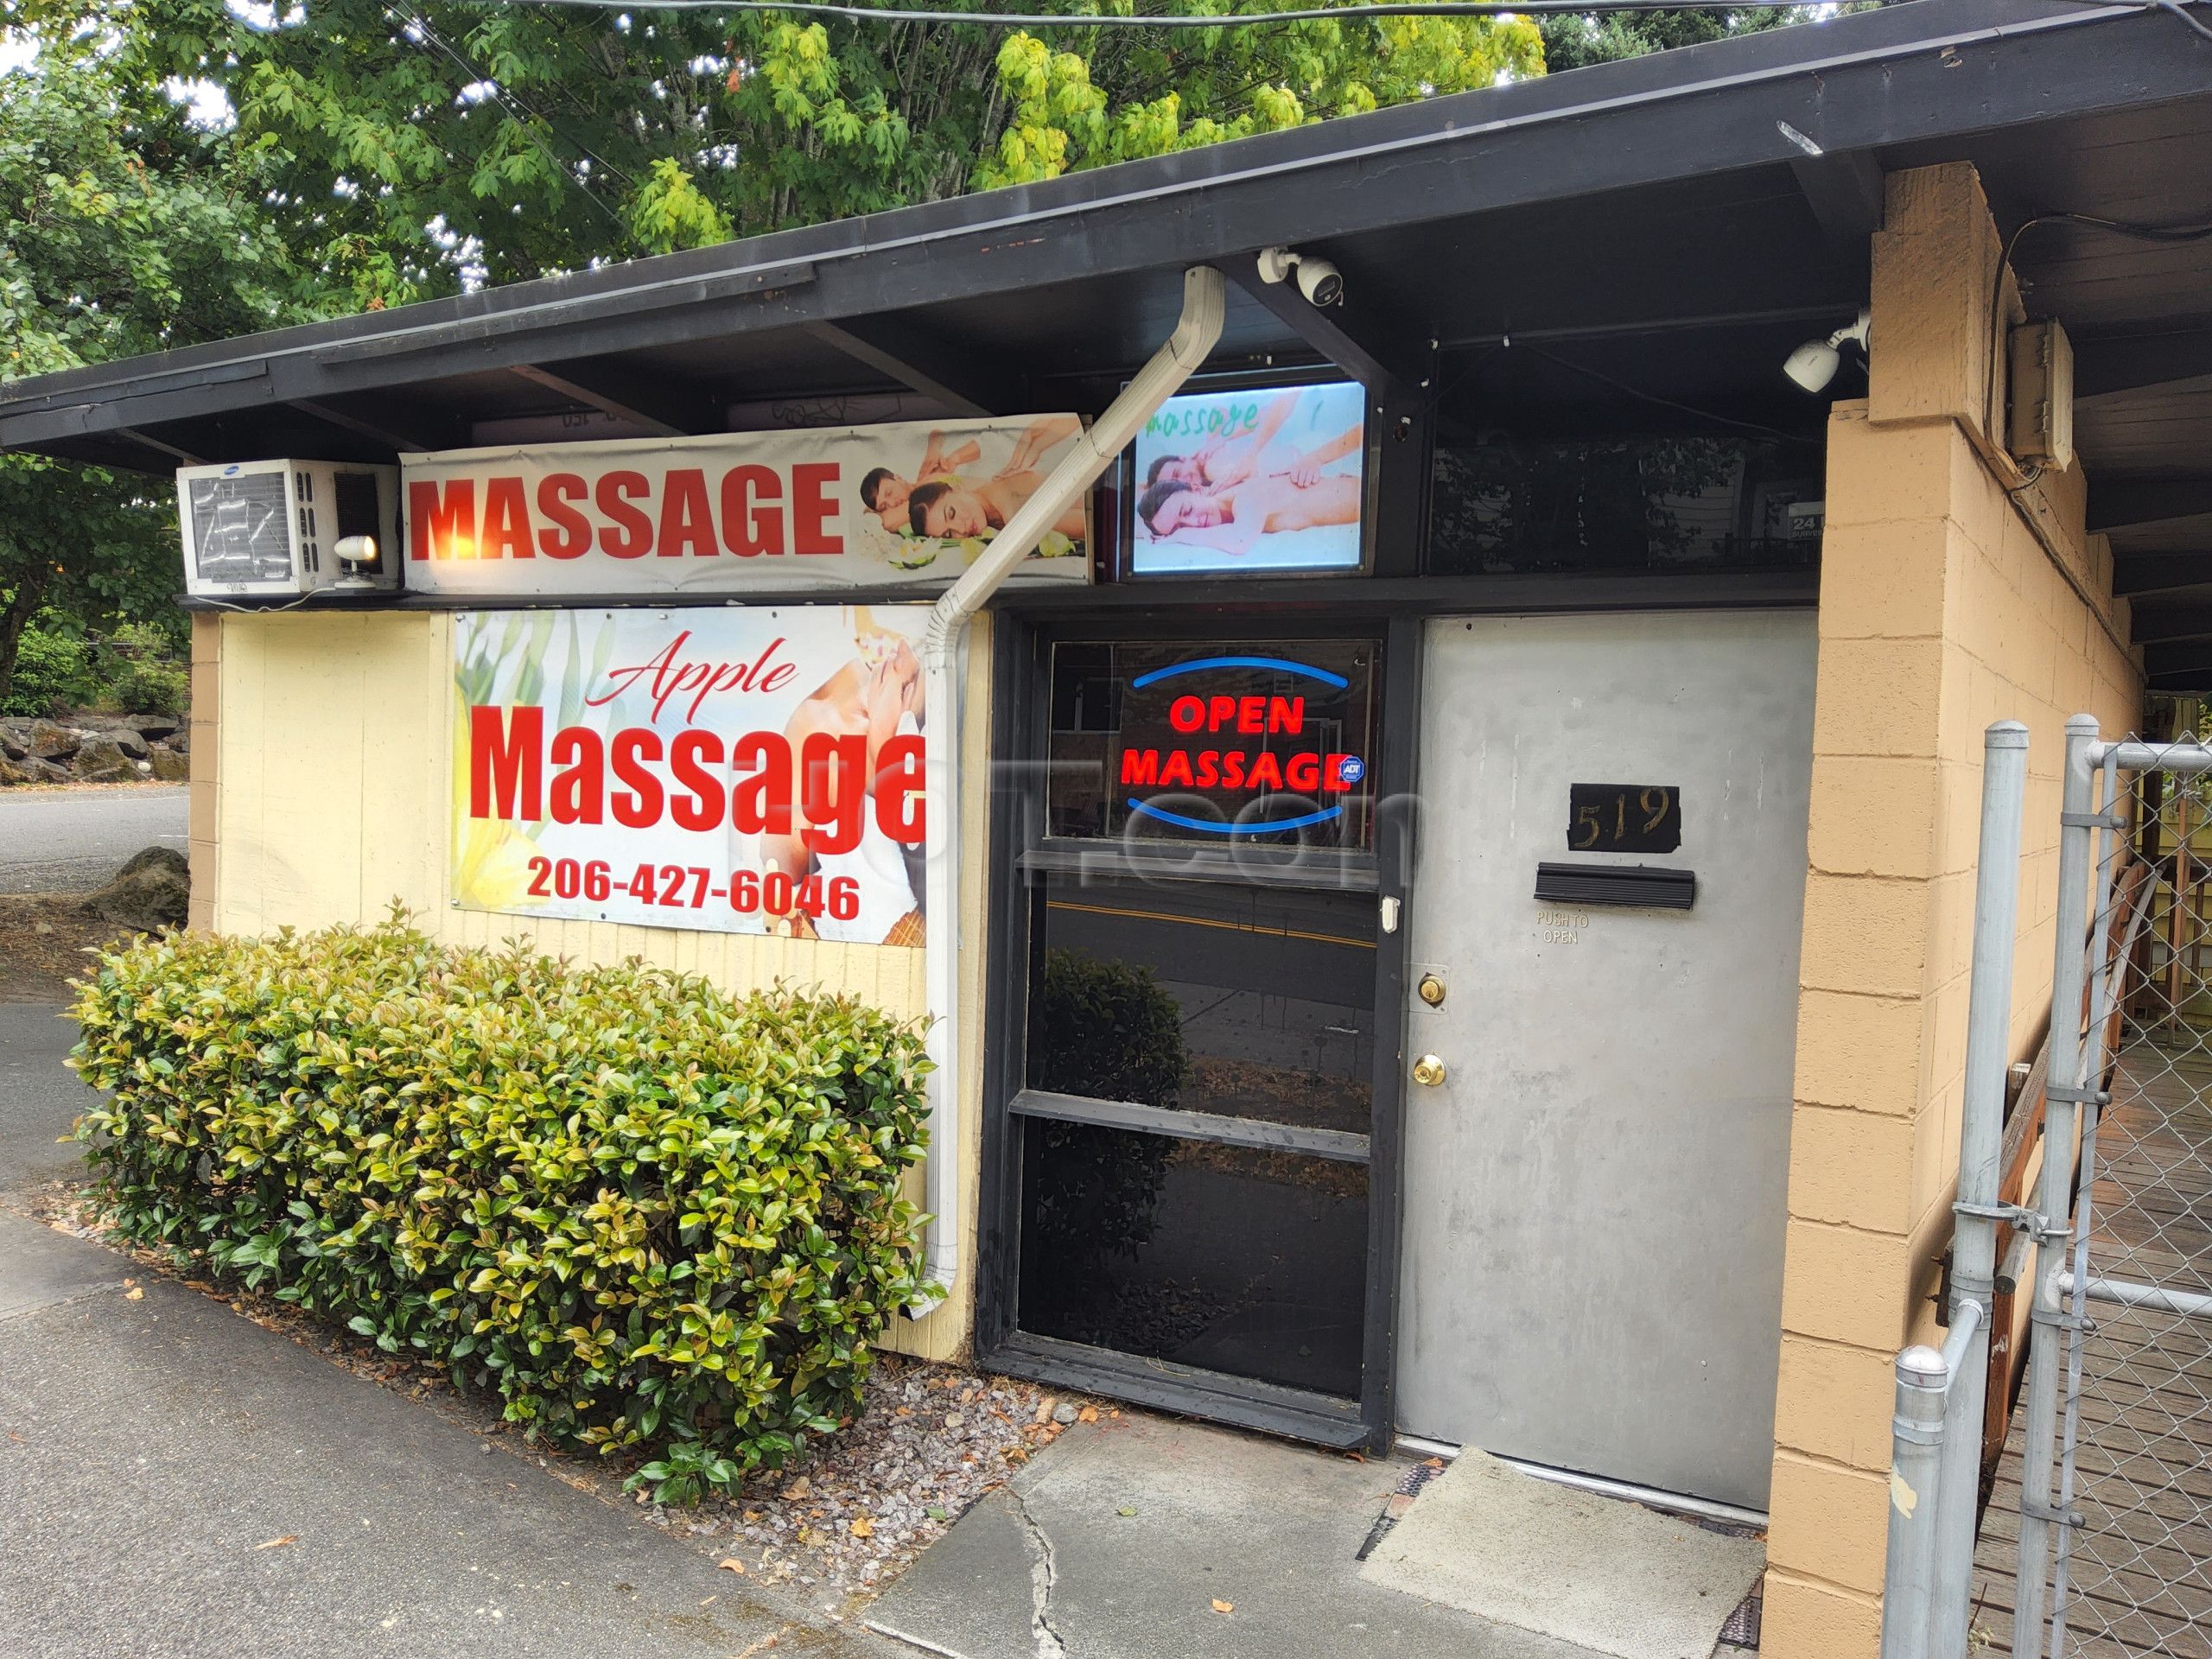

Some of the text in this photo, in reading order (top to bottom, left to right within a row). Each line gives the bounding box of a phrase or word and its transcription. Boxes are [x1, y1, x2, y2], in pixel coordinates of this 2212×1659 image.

[409, 462, 844, 562] MASSAGE
[585, 630, 799, 724] Apple
[1169, 696, 1305, 734] OPEN
[469, 705, 926, 855] Massage
[1121, 749, 1352, 791] MASSAGE
[1344, 764, 1359, 774] ADT
[1574, 786, 1669, 848] 519
[527, 856, 860, 920] 206-427-6046
[1535, 911, 1589, 928] PUSH TO
[1543, 929, 1578, 944] OPEN
